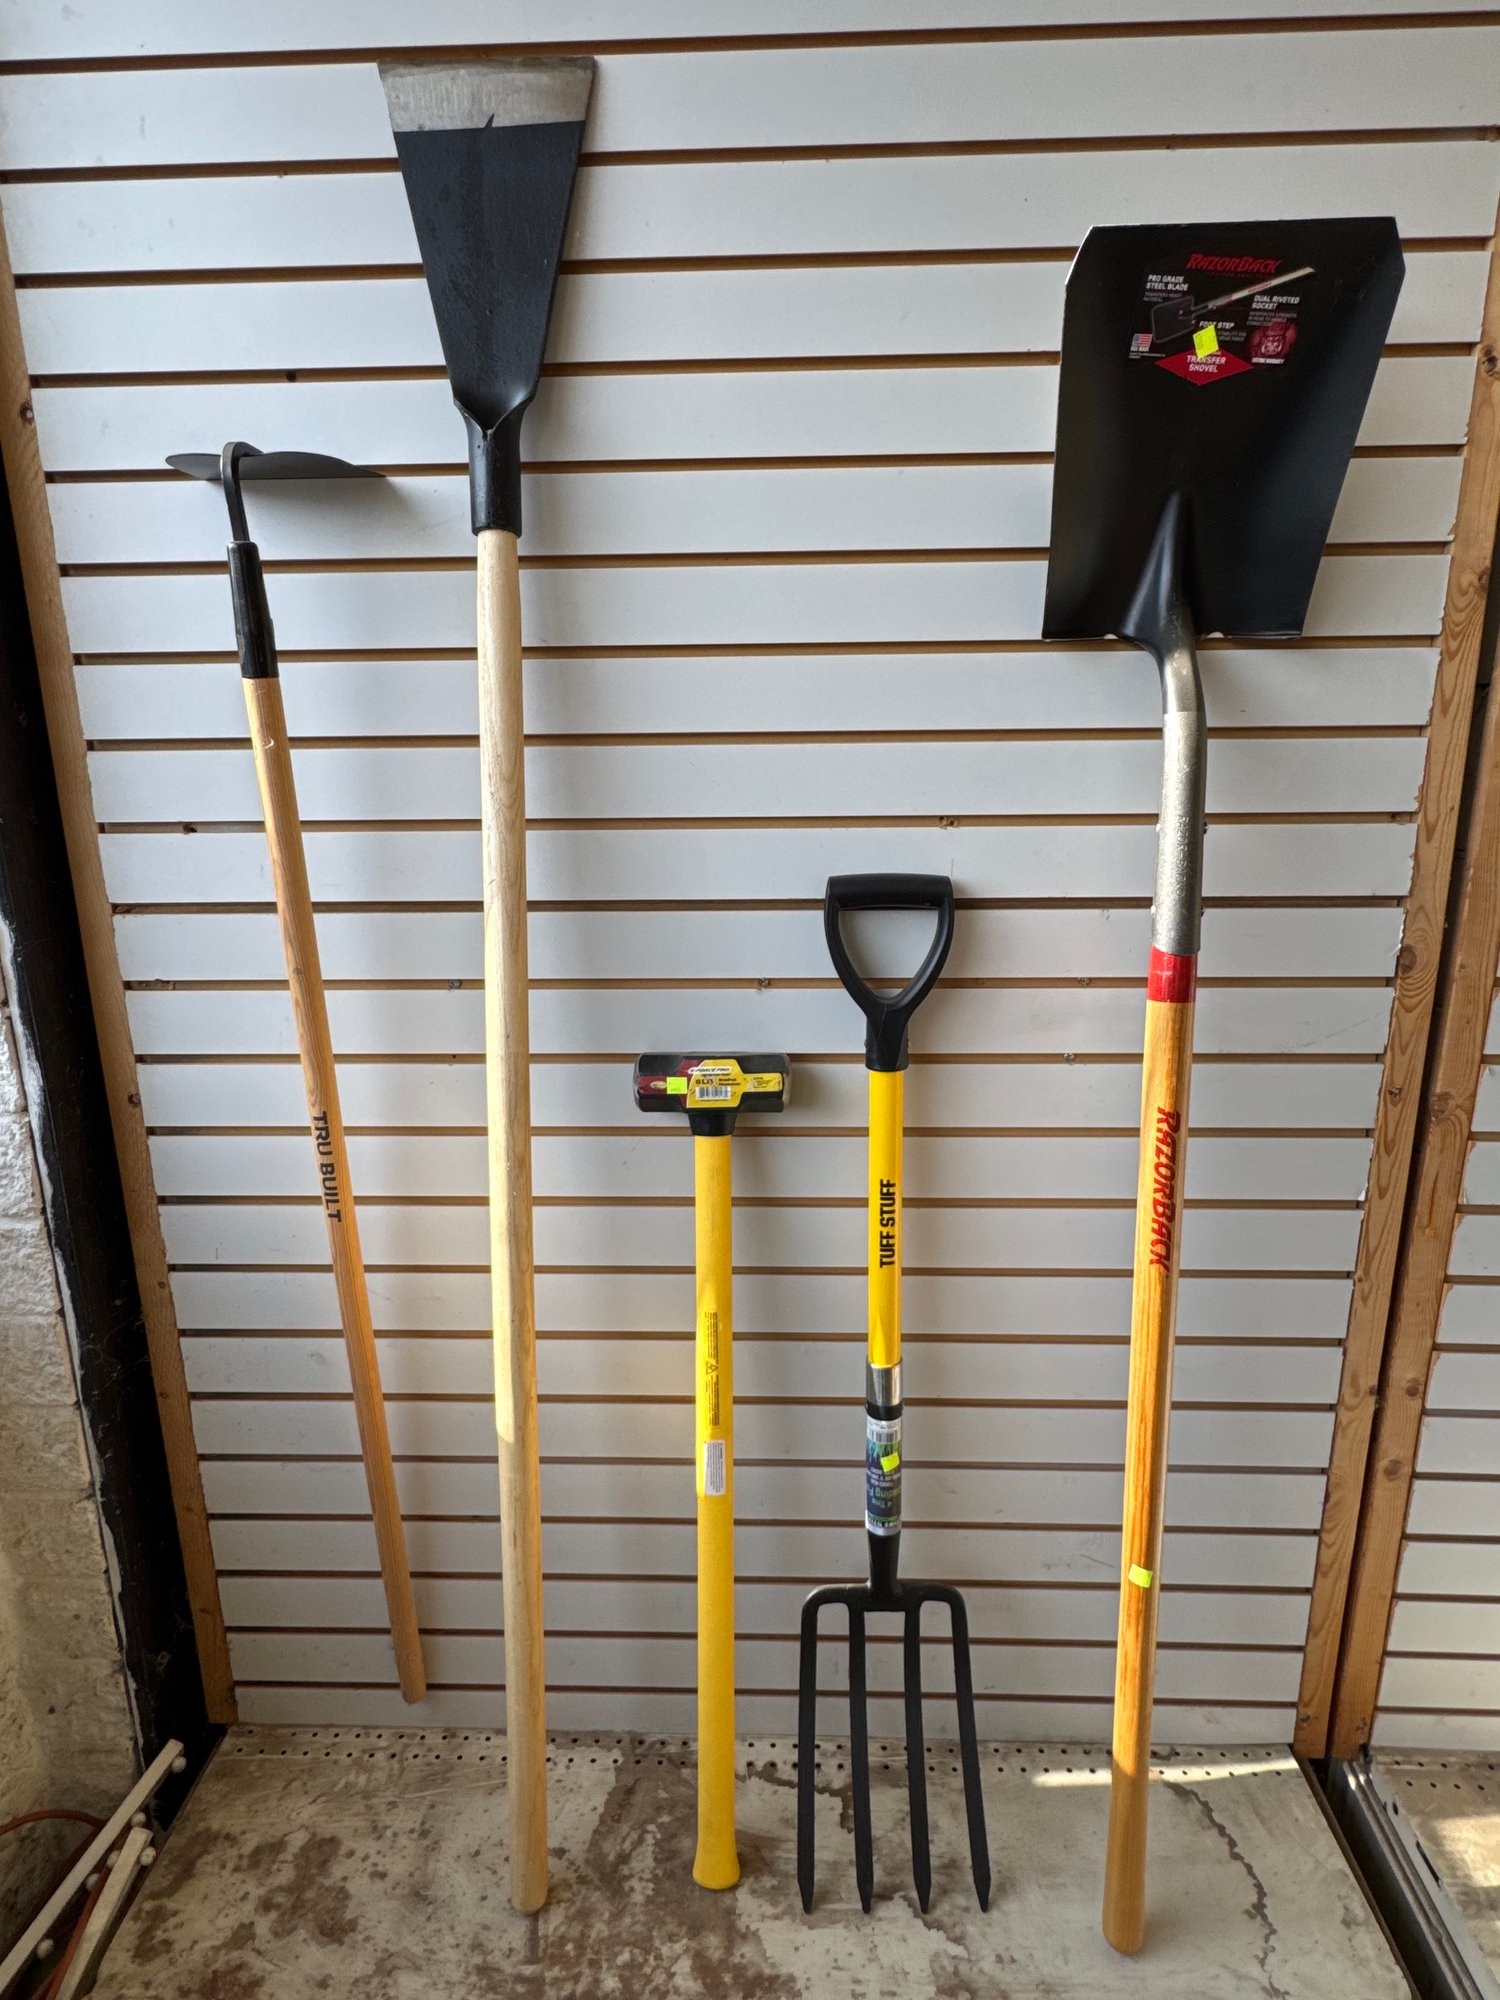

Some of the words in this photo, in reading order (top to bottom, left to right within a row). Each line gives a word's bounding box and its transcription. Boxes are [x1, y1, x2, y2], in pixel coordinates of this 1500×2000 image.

[1147, 274, 1161, 282] PRO
[1162, 275, 1184, 283] GRADE
[1145, 282, 1166, 290] STEEL
[1167, 283, 1189, 291] BLADE
[1253, 294, 1271, 302] DUAL
[1271, 295, 1300, 304] RIVETED
[1251, 302, 1279, 310] SOCKET
[1217, 321, 1236, 329] STEP
[1186, 355, 1227, 365] TRANSFER
[1188, 363, 1218, 373] SHOVEL
[313, 1110, 333, 1155] TRU
[320, 1162, 342, 1223] BUILT
[879, 1178, 896, 1228] STUFF
[879, 1230, 895, 1268] TUFF
